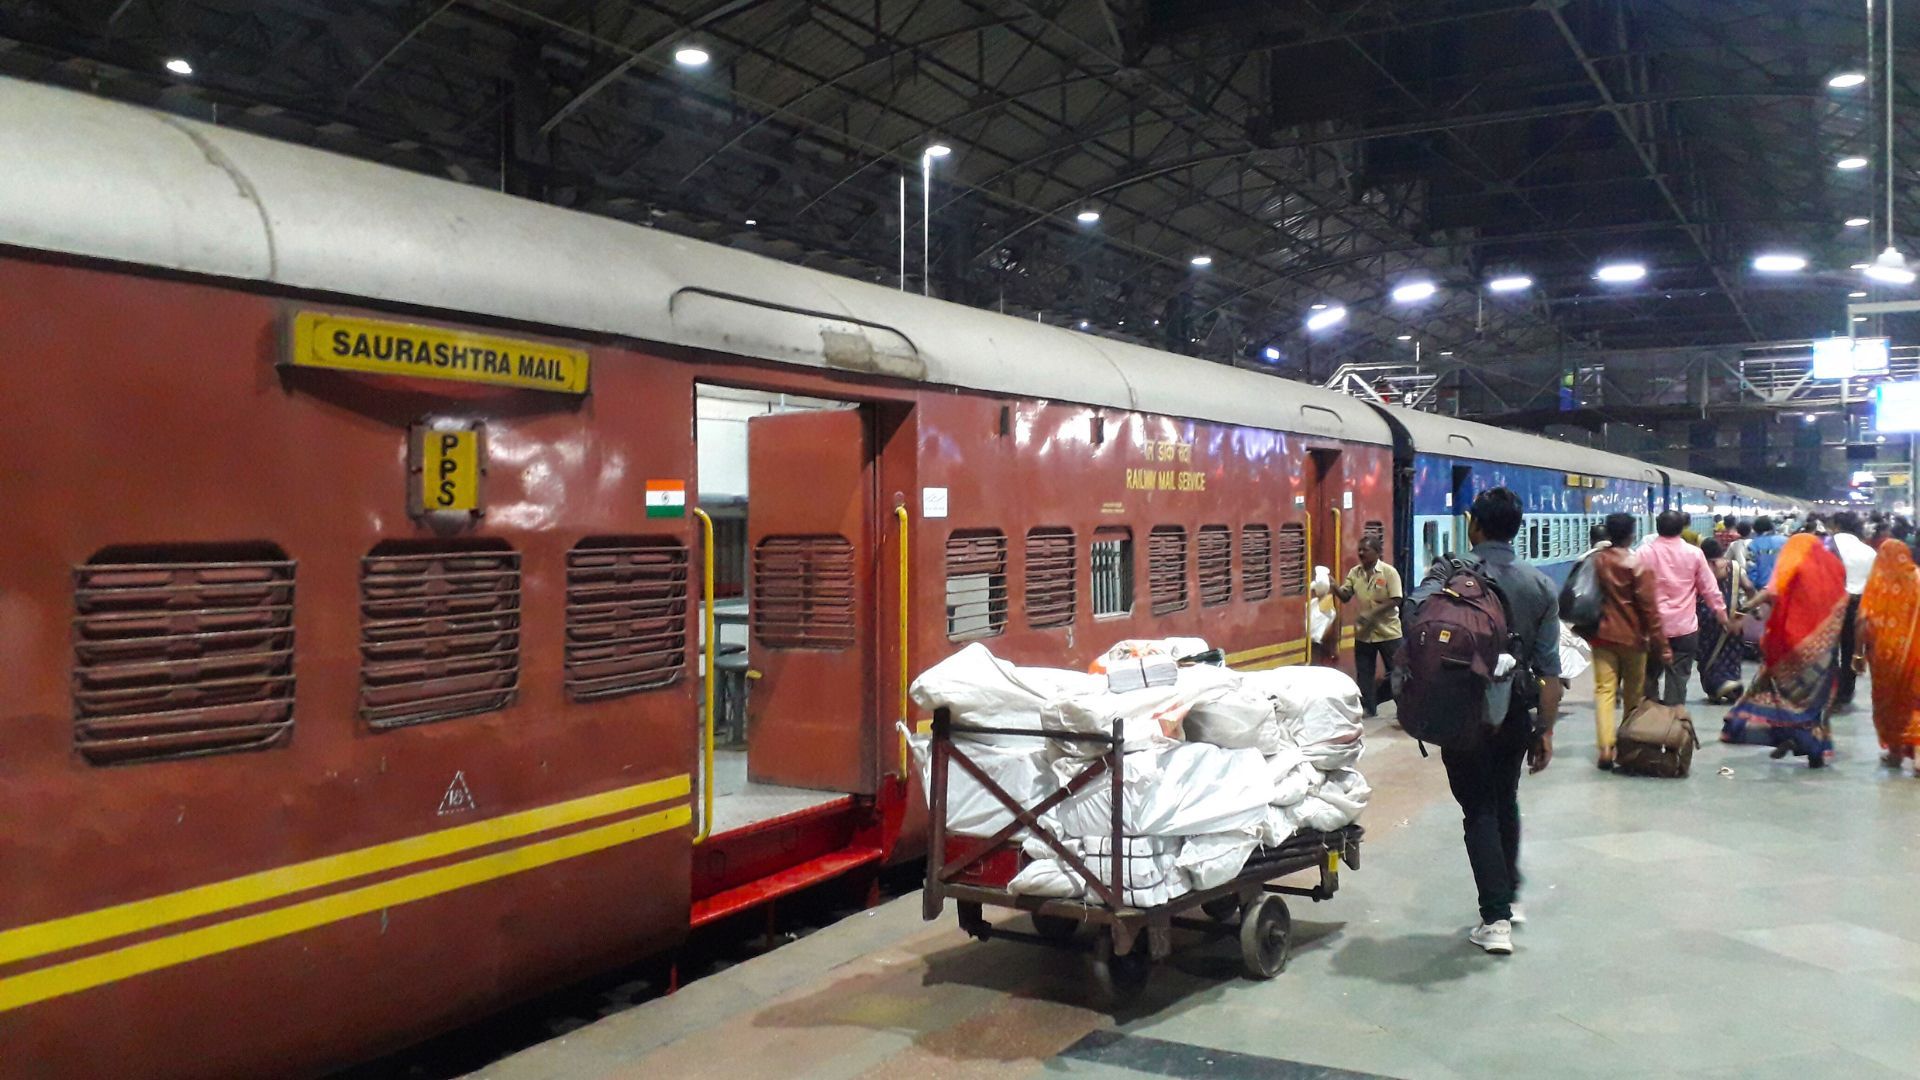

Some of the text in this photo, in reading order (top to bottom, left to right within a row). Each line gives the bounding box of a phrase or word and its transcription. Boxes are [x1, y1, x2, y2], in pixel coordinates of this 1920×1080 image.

[333, 330, 566, 382] SAURASHTRA MAIL
[437, 433, 459, 507] PPS
[1158, 470, 1177, 490] MAIL
[1178, 471, 1206, 491] SERVICE
